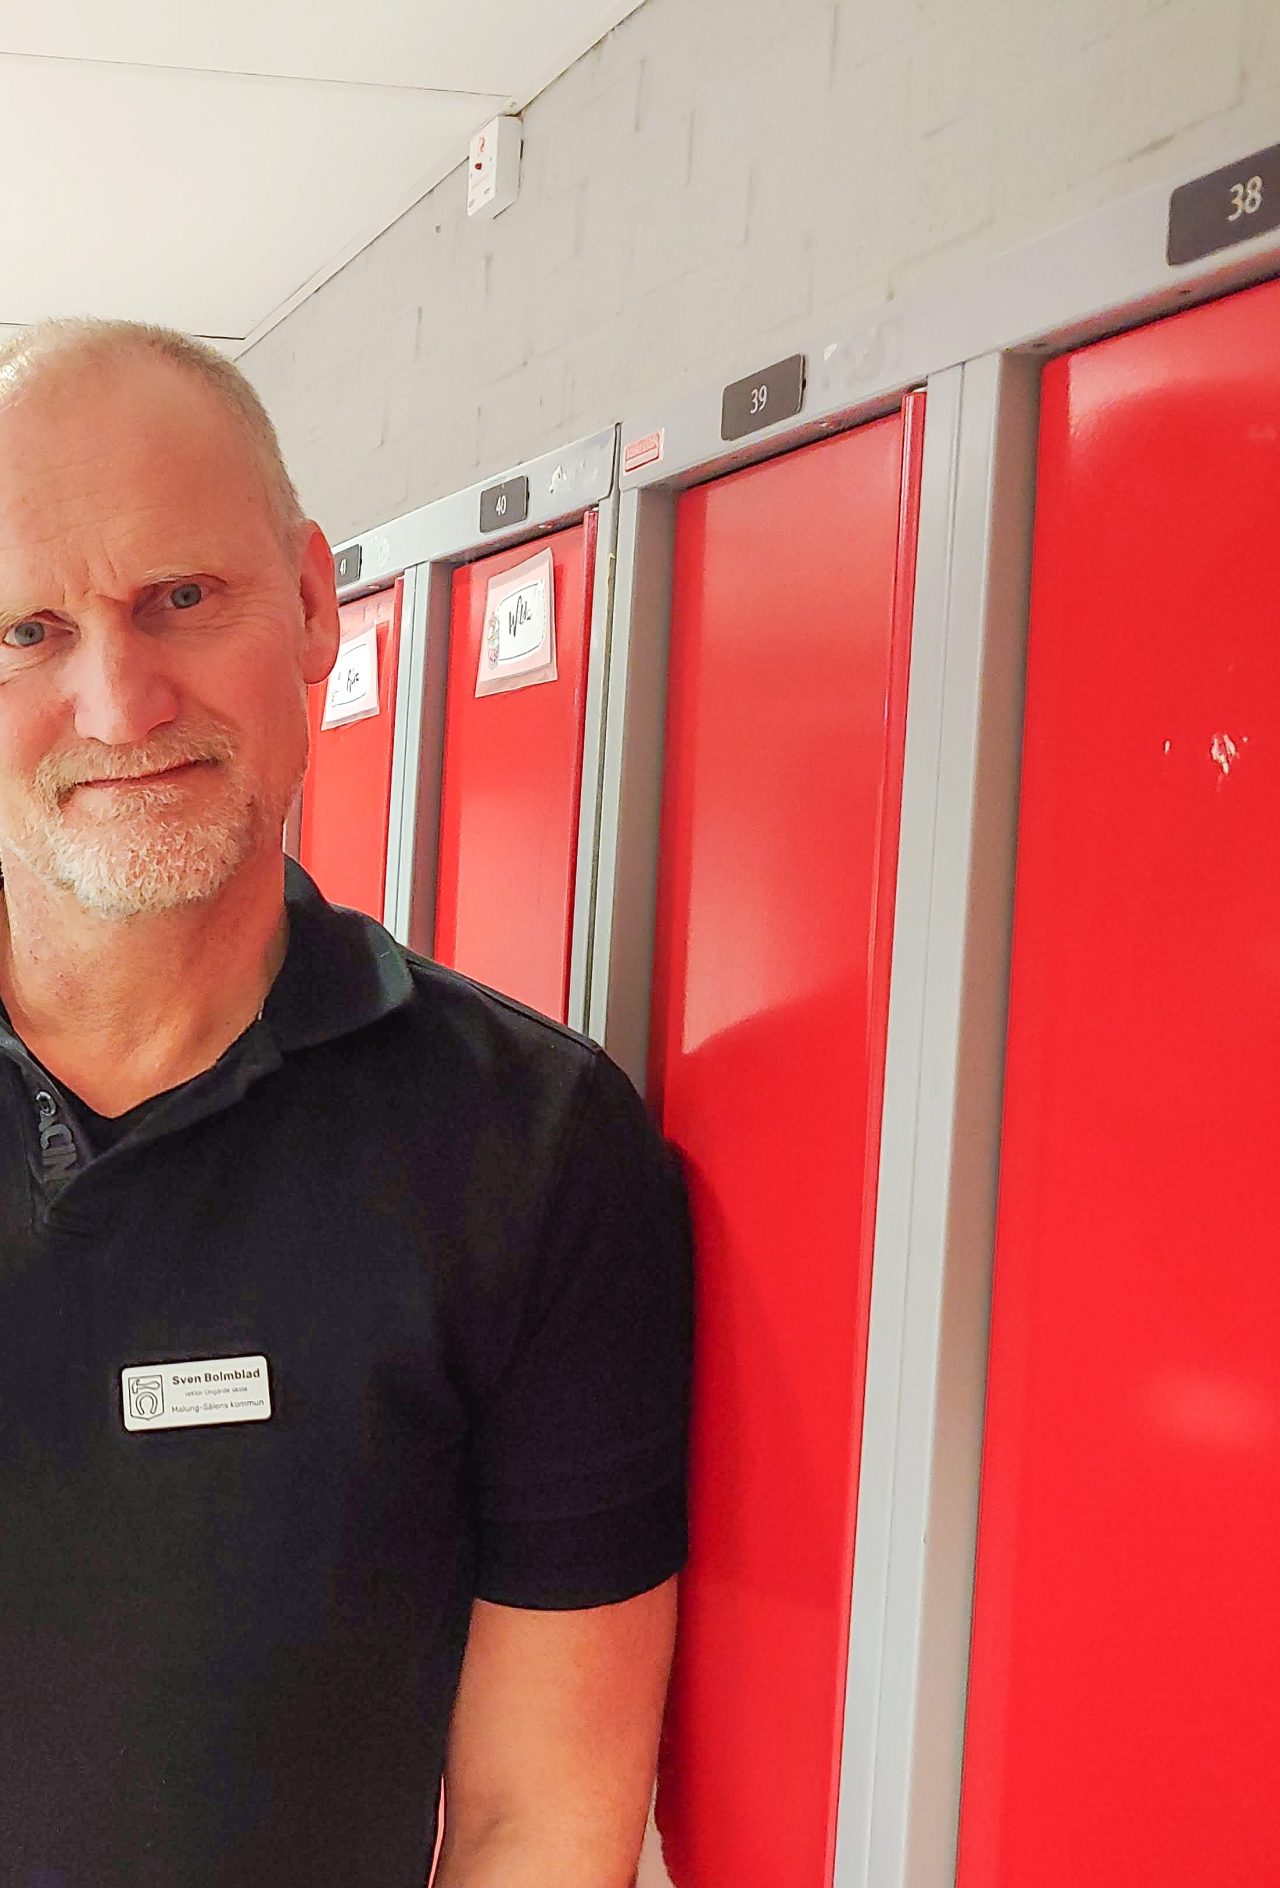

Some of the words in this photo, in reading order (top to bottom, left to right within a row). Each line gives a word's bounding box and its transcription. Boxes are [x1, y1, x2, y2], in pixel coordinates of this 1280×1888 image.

[1226, 175, 1263, 221] 38
[750, 385, 768, 414] 39
[495, 494, 507, 516] 40
[172, 1375, 202, 1386] Sven
[204, 1368, 261, 1383] Bolmblad
[230, 1399, 265, 1409] kommun
